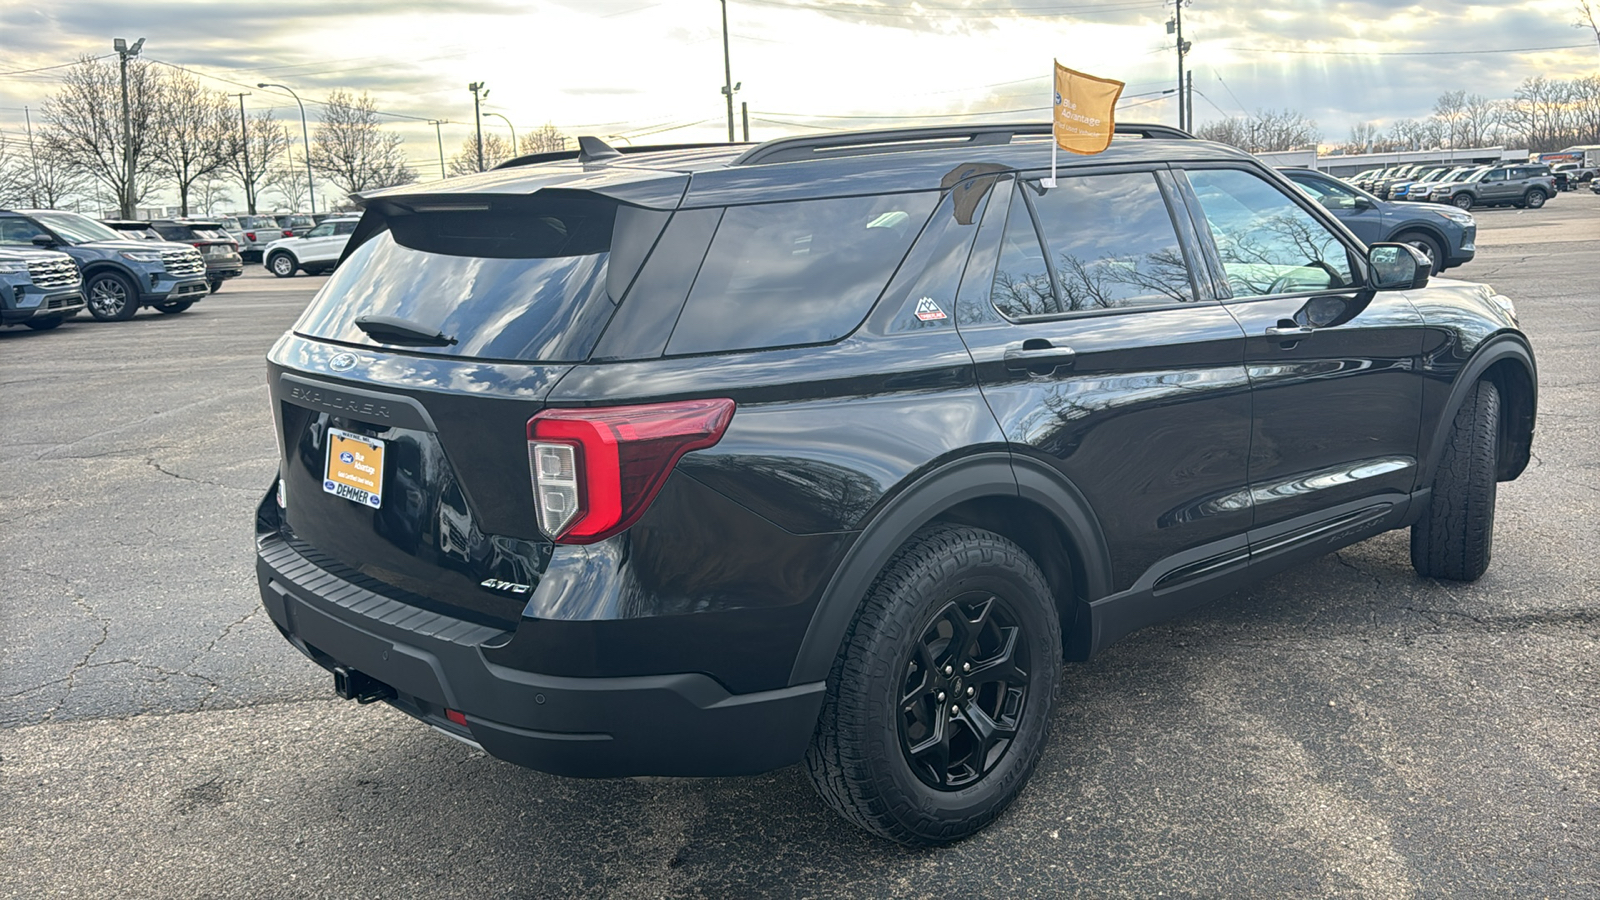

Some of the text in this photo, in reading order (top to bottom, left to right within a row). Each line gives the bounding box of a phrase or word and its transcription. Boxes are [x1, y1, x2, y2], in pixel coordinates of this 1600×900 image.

[1062, 98, 1077, 111] Blue
[1061, 108, 1101, 127] Advantage
[290, 387, 391, 418] EXPLORER
[336, 483, 369, 504] DEMMER
[480, 578, 530, 593] 4WD
